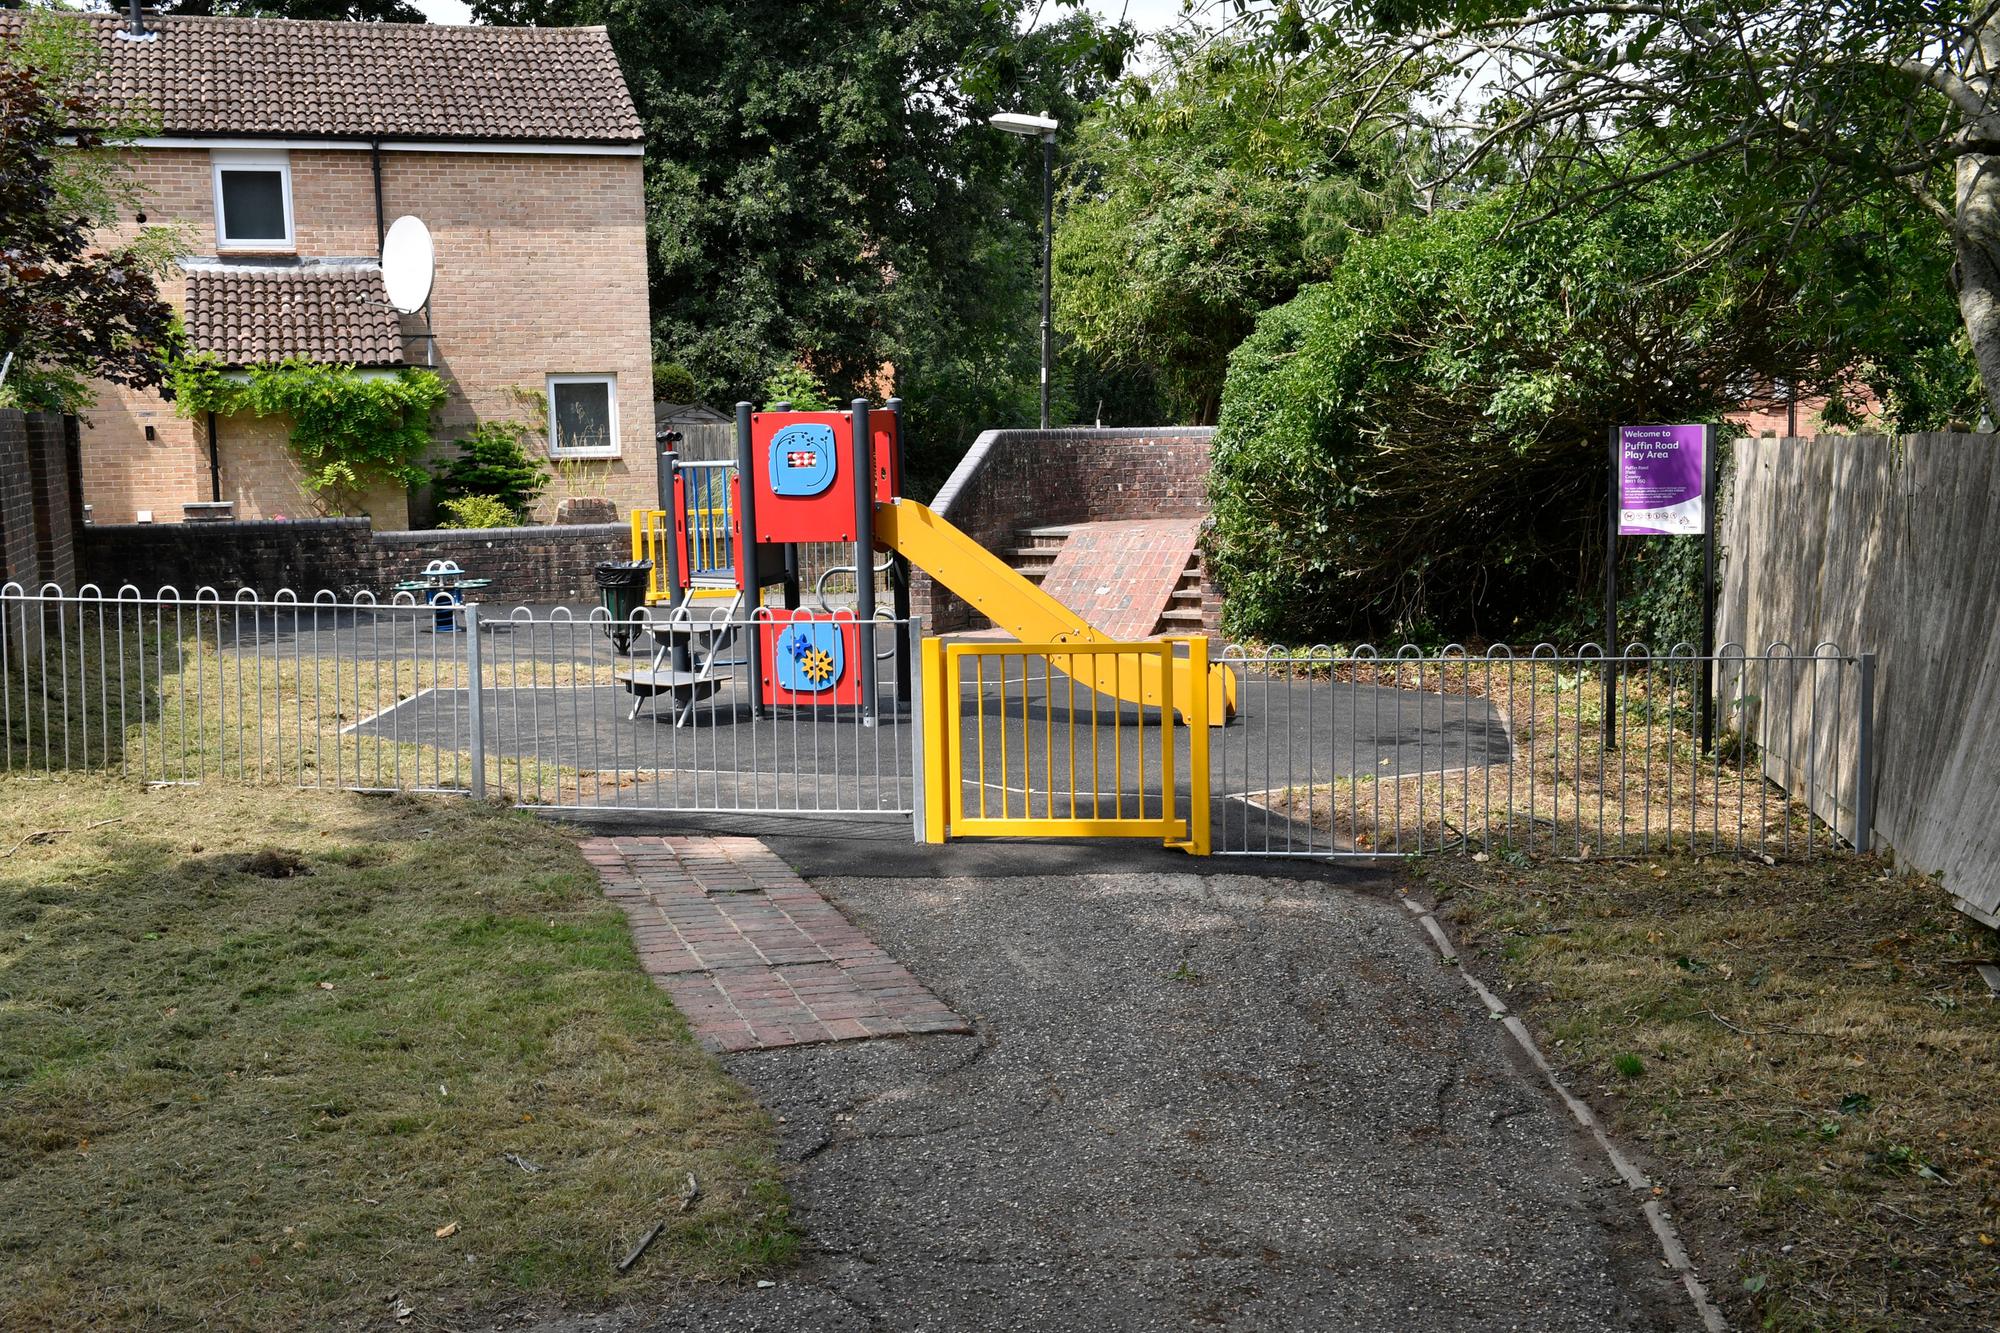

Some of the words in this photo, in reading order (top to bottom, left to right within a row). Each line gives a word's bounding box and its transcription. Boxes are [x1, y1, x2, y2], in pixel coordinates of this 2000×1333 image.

[1625, 442, 1652, 450] Puffin
[1655, 441, 1679, 449] Road
[1625, 451, 1645, 460] Play
